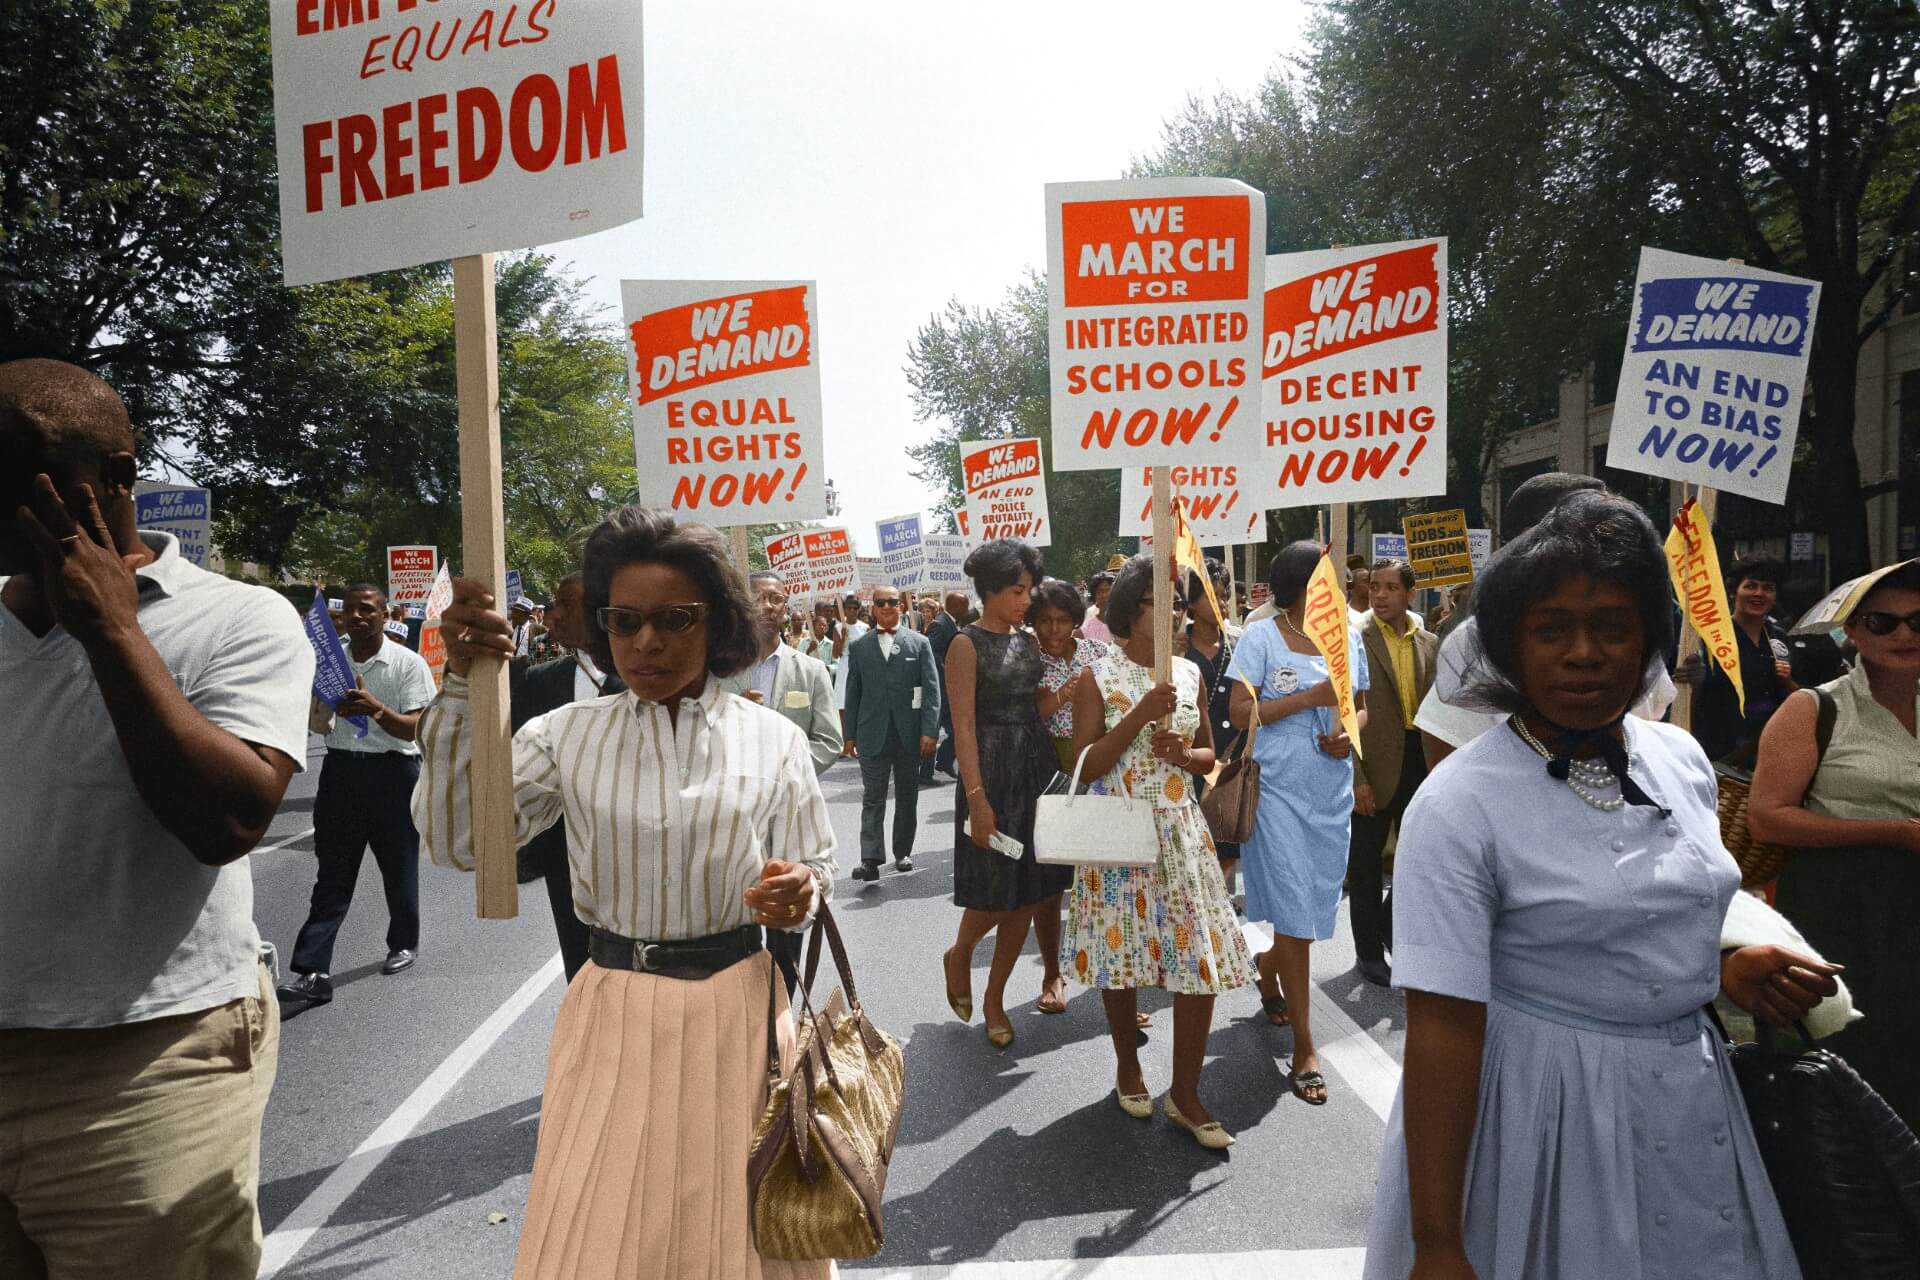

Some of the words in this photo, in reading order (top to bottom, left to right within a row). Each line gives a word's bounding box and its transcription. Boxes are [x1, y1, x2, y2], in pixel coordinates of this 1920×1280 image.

[361, 0, 556, 79] EQUALS
[303, 54, 627, 213] FREEDOM
[1129, 206, 1184, 234] WE
[1078, 237, 1236, 278] MARCH
[1128, 280, 1189, 298] FOR
[1310, 263, 1377, 314] WE
[1694, 280, 1760, 311] WE
[690, 298, 754, 341] WE
[1264, 286, 1432, 369] DEMAND
[1646, 313, 1802, 345] DEMAND
[1065, 312, 1248, 350] INTEGRATED
[649, 325, 803, 391] DEMAND
[1067, 357, 1247, 395] SCHOOLS
[1280, 365, 1422, 405] DECENT
[1644, 358, 1699, 391] AN
[1713, 370, 1790, 409] END
[666, 398, 796, 429] EQUAL
[1080, 395, 1240, 450] NOW!
[1645, 390, 1691, 421] TO
[1701, 404, 1782, 441] BIAS
[1266, 405, 1436, 447] HOUSING
[667, 431, 802, 465] RIGHTS
[988, 445, 1016, 465] WE
[1638, 425, 1778, 479] NOW!
[972, 456, 1036, 488] DEMAND
[1278, 435, 1428, 489] NOW!
[1143, 465, 1237, 487] RGHTS
[671, 463, 808, 512] NOW!
[978, 489, 1000, 500] AN
[1005, 487, 1034, 497] END
[159, 492, 185, 506] WE
[991, 502, 1025, 513] POLICE
[1140, 489, 1239, 521] W!
[142, 503, 204, 521] DEMAND
[982, 512, 1033, 524] BRUTALITY
[819, 533, 832, 541] WE
[885, 528, 918, 545] MARCH
[894, 522, 906, 532] WE
[983, 518, 1042, 542] NOW!
[1409, 527, 1446, 544] JOBS
[782, 535, 799, 549] WE
[808, 539, 846, 552] MARCH
[1377, 543, 1407, 552] MARCH
[1411, 541, 1467, 561] FREEDOM
[394, 557, 430, 566] MARCH
[773, 547, 802, 564] DEMA
[793, 560, 806, 569] EN
[808, 555, 852, 569] INTEGRATED
[884, 552, 903, 564] FIRST
[903, 547, 923, 559] CLASS
[884, 557, 925, 574] CITIZENSHIP
[783, 575, 809, 586] RUTALIT
[811, 565, 854, 579] SCHOOLS
[892, 568, 924, 588] NOW!
[929, 571, 962, 582] REEDOM
[817, 573, 854, 592] NOW!
[395, 589, 432, 600] NOW!
[410, 609, 425, 617] UA
[1710, 628, 1723, 643] IN
[308, 607, 329, 648] MARCH
[327, 652, 350, 692] WASHINGT
[1715, 641, 1738, 672] '63
